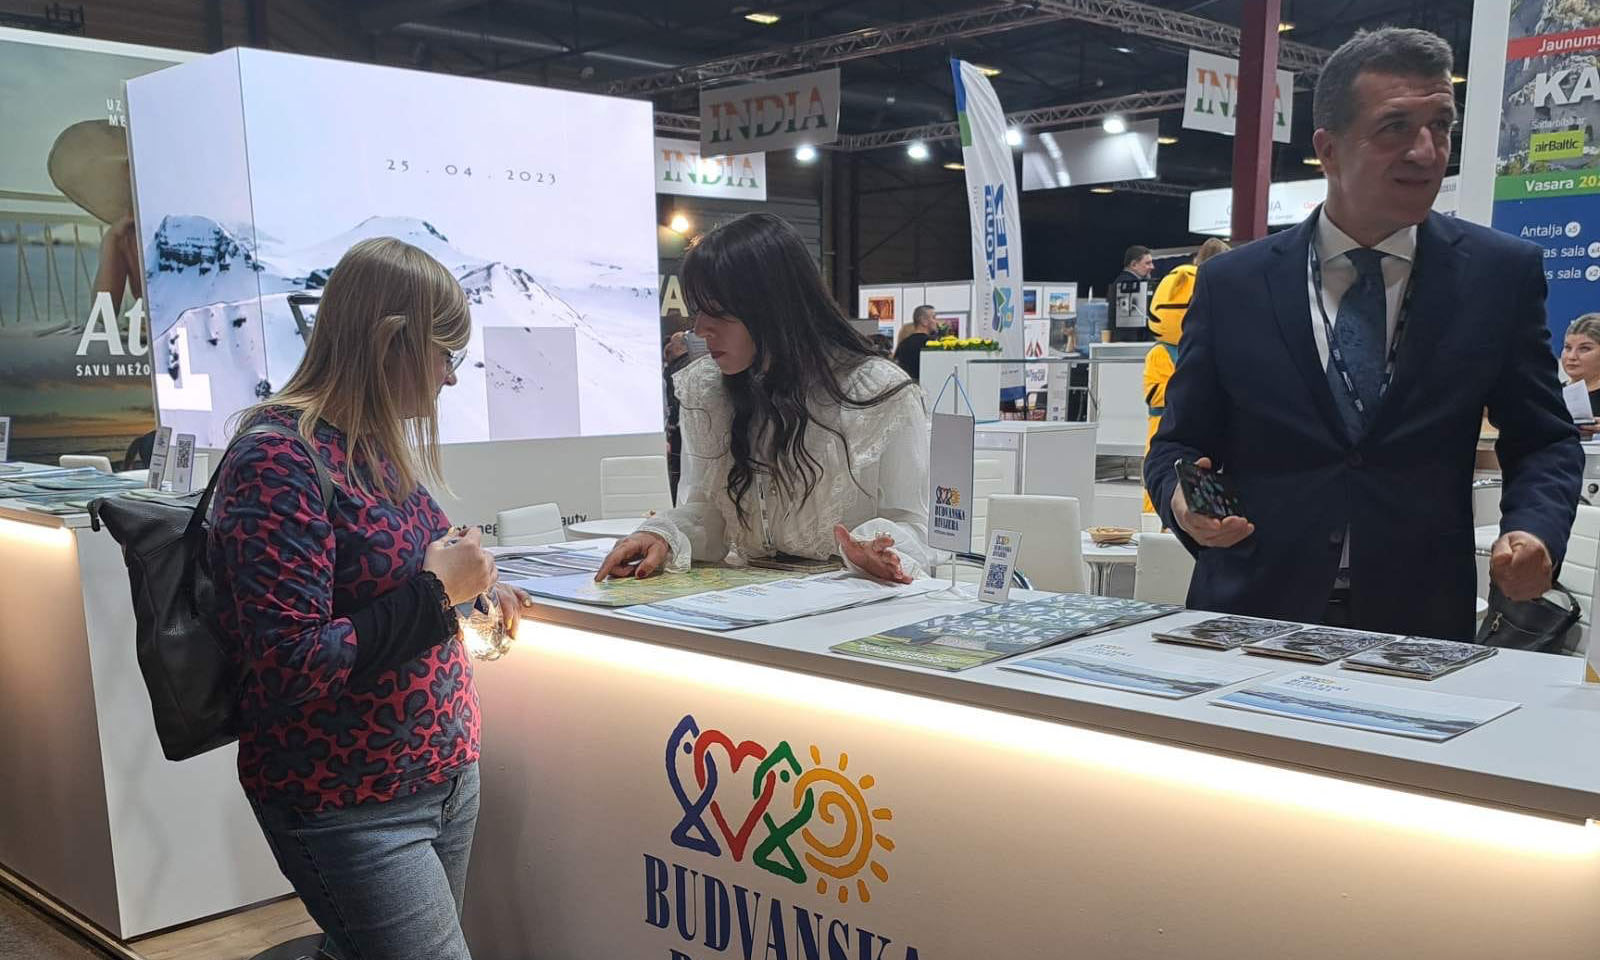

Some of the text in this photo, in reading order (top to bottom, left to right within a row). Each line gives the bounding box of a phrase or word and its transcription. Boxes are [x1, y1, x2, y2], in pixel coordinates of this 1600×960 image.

[106, 98, 122, 112] UZ
[1193, 67, 1286, 127] INA
[707, 86, 828, 143] INDIA
[1534, 137, 1579, 153] airBaltic
[386, 159, 409, 172] 25
[445, 164, 472, 178] 04
[506, 169, 556, 186] 2023
[662, 148, 760, 188] INDIA
[1525, 179, 1574, 192] Vasara
[1520, 223, 1563, 239] Antalja
[1561, 244, 1585, 258] sala
[1557, 266, 1582, 279] sala
[659, 274, 689, 318] A
[76, 292, 149, 357] At
[76, 364, 110, 377] SAVU
[643, 853, 920, 960] BUDVANS
